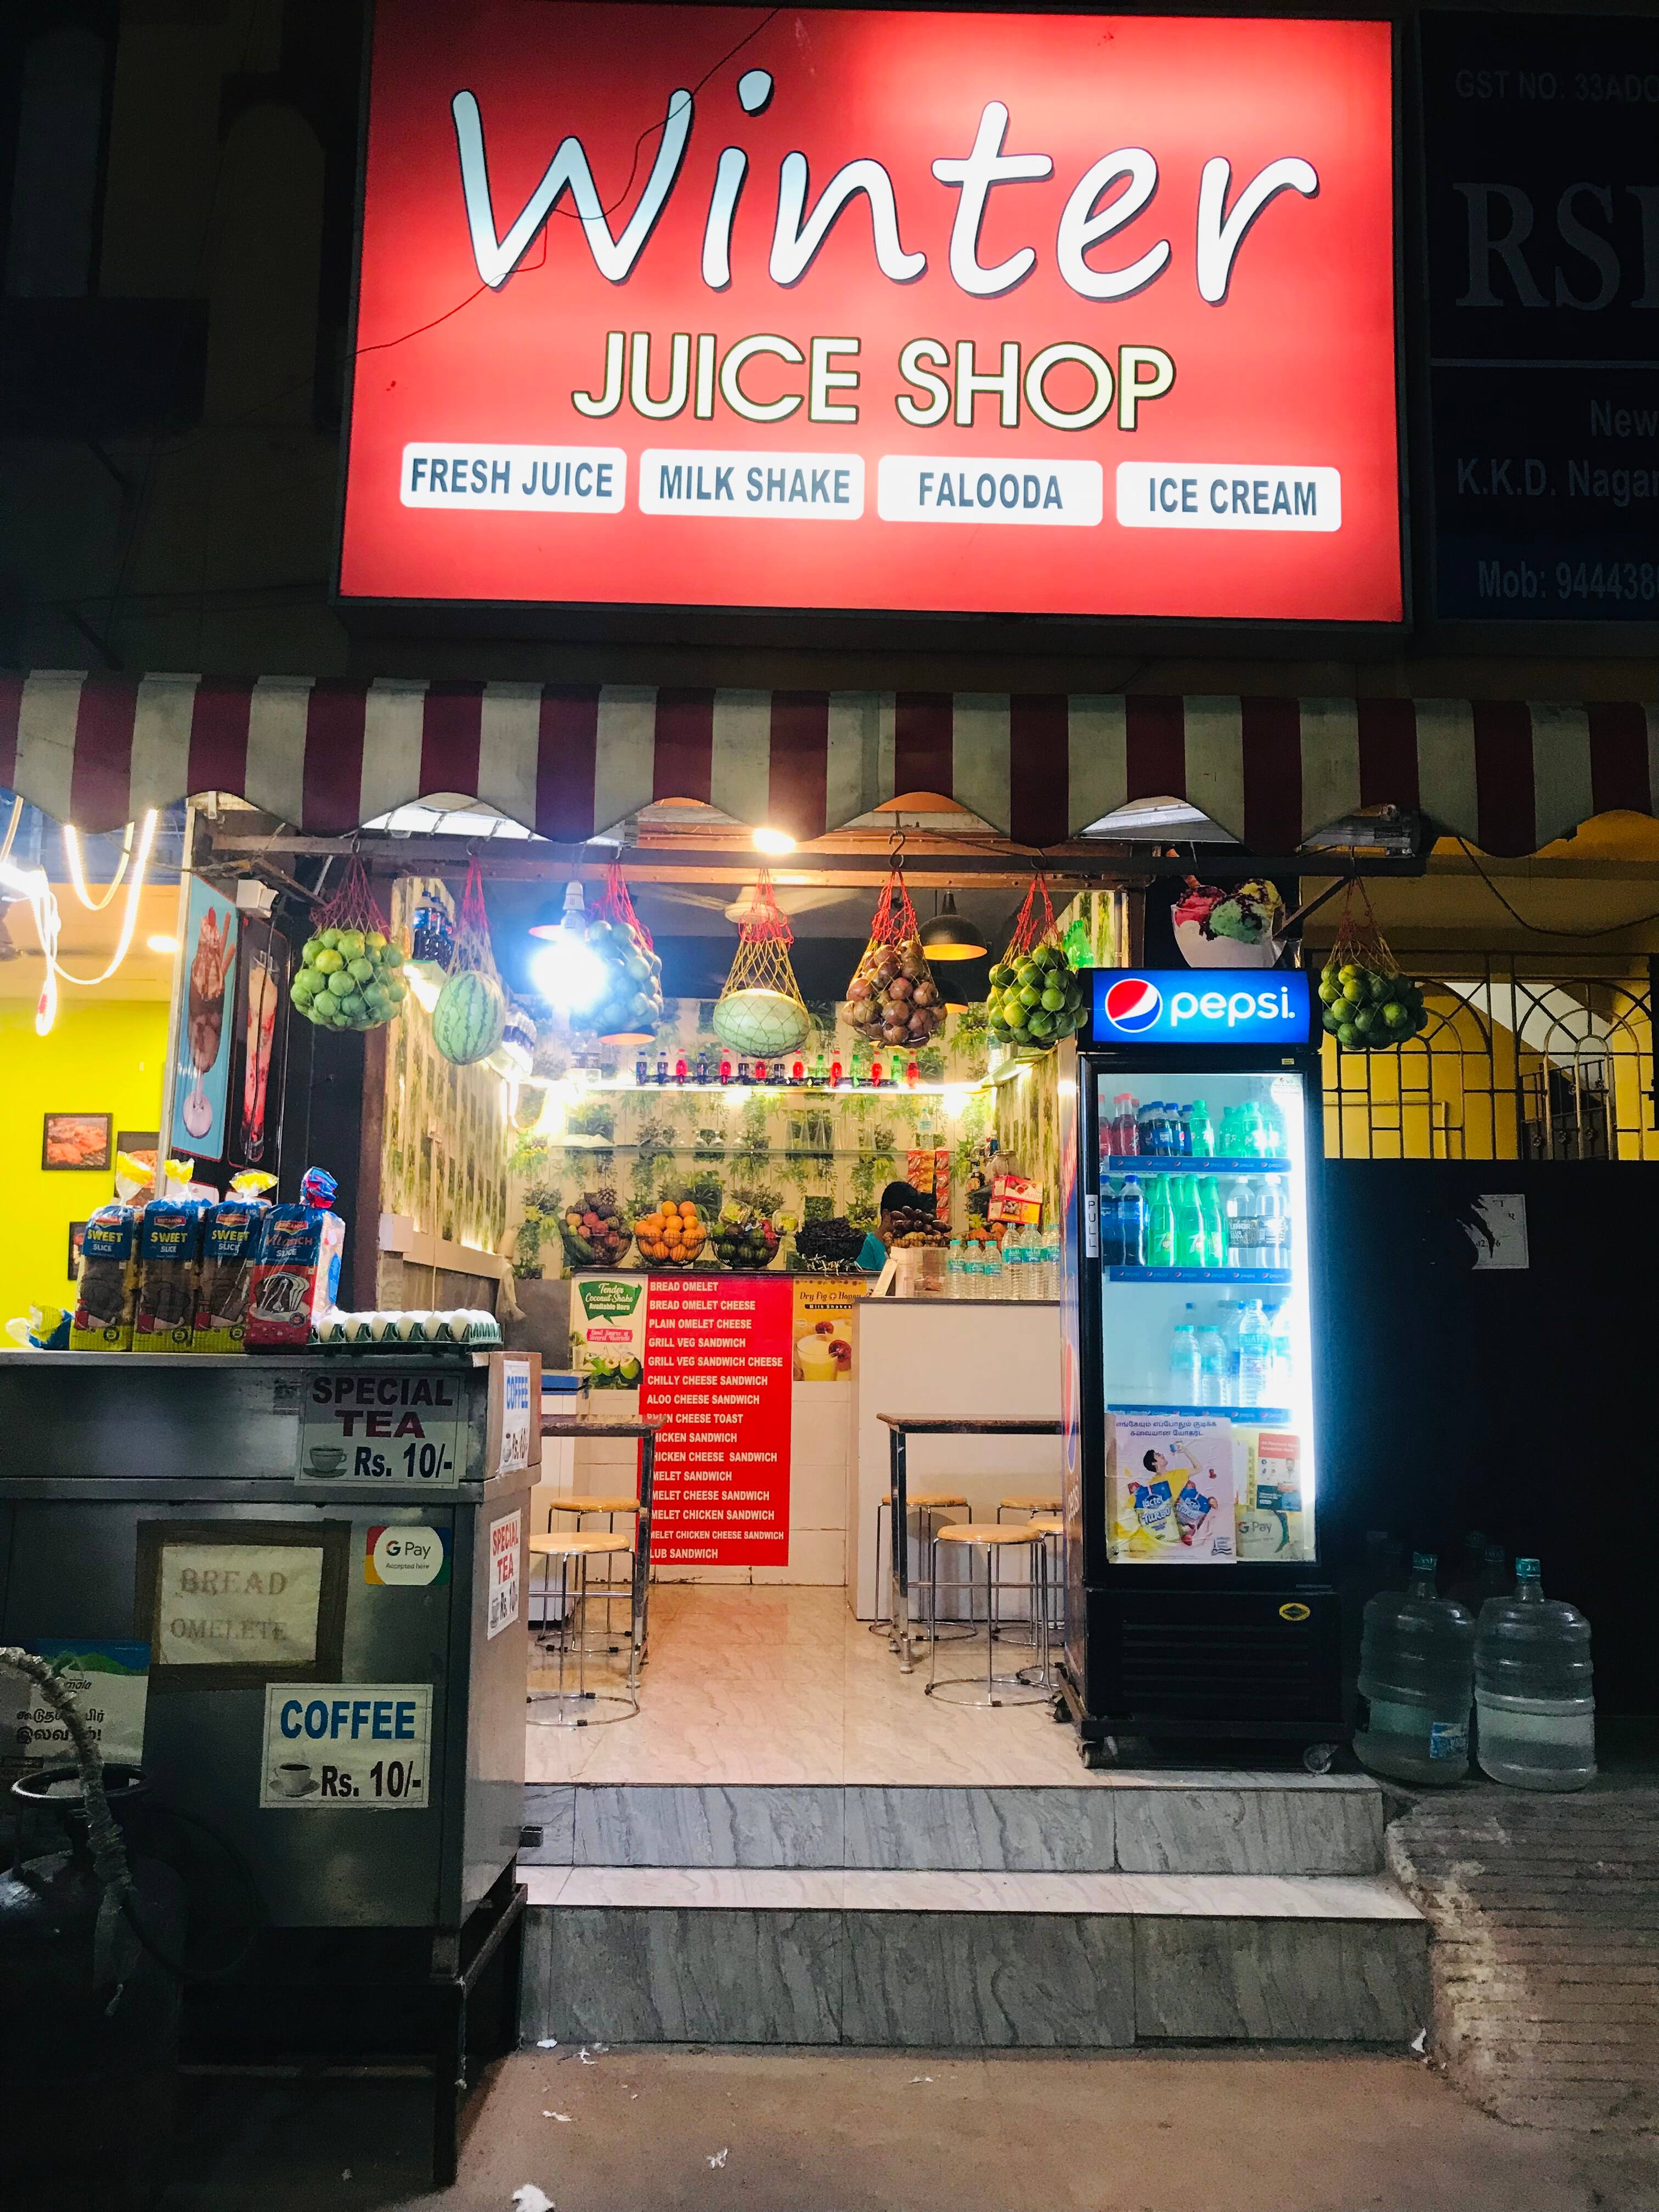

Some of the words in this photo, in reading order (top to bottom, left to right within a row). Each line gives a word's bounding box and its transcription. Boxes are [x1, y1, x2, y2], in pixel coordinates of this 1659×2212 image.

[1455, 70, 1510, 99] GST
[452, 69, 1319, 306] Winter
[573, 331, 861, 426] JUICE
[895, 338, 1176, 431] SHOP
[411, 458, 510, 494] FRESH
[522, 461, 613, 497] JUICE
[1457, 458, 1556, 495] K.K.D.
[659, 465, 735, 501] MILK
[746, 467, 851, 504] SHAKE
[919, 472, 1063, 510] FALOODA
[1150, 477, 1198, 513] ICE
[1210, 479, 1317, 516] CREAM
[1479, 560, 1546, 599] Mob:
[1556, 562, 1659, 600] 944438
[1171, 986, 1290, 1028] pepsi
[88, 1229, 123, 1243] SWEET
[150, 1232, 188, 1243] SWEET
[212, 1229, 250, 1242] SWEET
[93, 1244, 112, 1252] SLICE
[651, 1282, 680, 1291] BREAD
[682, 1282, 718, 1291] OMELET
[585, 1293, 611, 1303] Coconut
[800, 1291, 814, 1301] Dry
[816, 1291, 827, 1301] Fig
[650, 1300, 680, 1310] BREAD
[682, 1300, 718, 1310] OMELET
[720, 1301, 755, 1310] CHEESE
[649, 1319, 675, 1328] PLAIN
[678, 1319, 714, 1329] OMELET
[716, 1319, 752, 1329] CHEESE
[649, 1338, 674, 1347] GRILL
[678, 1338, 695, 1347] VEG
[698, 1338, 746, 1347] SANDWICH
[648, 1357, 674, 1366] GRILL
[677, 1357, 695, 1366] VEG
[698, 1357, 745, 1366] SANDWICH
[748, 1357, 783, 1367] CHEESE
[648, 1375, 680, 1385] CHILLY
[682, 1376, 718, 1385] CHEESE
[720, 1376, 768, 1385] SANDWICH
[312, 1377, 453, 1407] SPECIAL
[506, 1376, 528, 1410] COFFEE
[647, 1395, 671, 1404] ALOO
[674, 1395, 709, 1404] CHEESE
[712, 1395, 759, 1404] SANDWICH
[335, 1409, 426, 1438] TEA
[676, 1414, 711, 1423] CHEESE
[714, 1414, 743, 1423] TOAST
[655, 1433, 686, 1442] HICKEN
[690, 1433, 737, 1442] SANDWICH
[354, 1446, 392, 1478] Rs.
[403, 1442, 453, 1479] 10/-
[654, 1452, 686, 1462] HICKEN
[689, 1452, 724, 1462] CHEESE
[730, 1452, 777, 1462] SANDWICH
[653, 1471, 681, 1481] MELET
[684, 1471, 732, 1481] SANDWICH
[652, 1491, 681, 1500] MELET
[684, 1491, 719, 1500] CHEESE
[722, 1491, 770, 1500] SANDWICH
[652, 1510, 680, 1519] MELET
[683, 1510, 724, 1519] CHICKEN
[726, 1510, 775, 1520] SANDWICH
[1142, 1506, 1171, 1525] TURBO
[1251, 1521, 1272, 1533] Pay
[493, 1520, 518, 1556] SPECIAL
[651, 1531, 674, 1539] MELET
[676, 1531, 710, 1539] CHICKEN
[712, 1531, 742, 1539] CHEESE
[744, 1531, 784, 1539] SANDWICH
[405, 1542, 431, 1559] Pay
[650, 1549, 667, 1558] LUB
[670, 1549, 718, 1559] SANDWICH
[498, 1553, 514, 1584] TEA
[180, 1568, 287, 1595] BREAD
[170, 1618, 286, 1640] OMELETE
[280, 1700, 416, 1740] COFFEE
[320, 1765, 360, 1798] Rs.
[370, 1760, 422, 1798] 10/-
